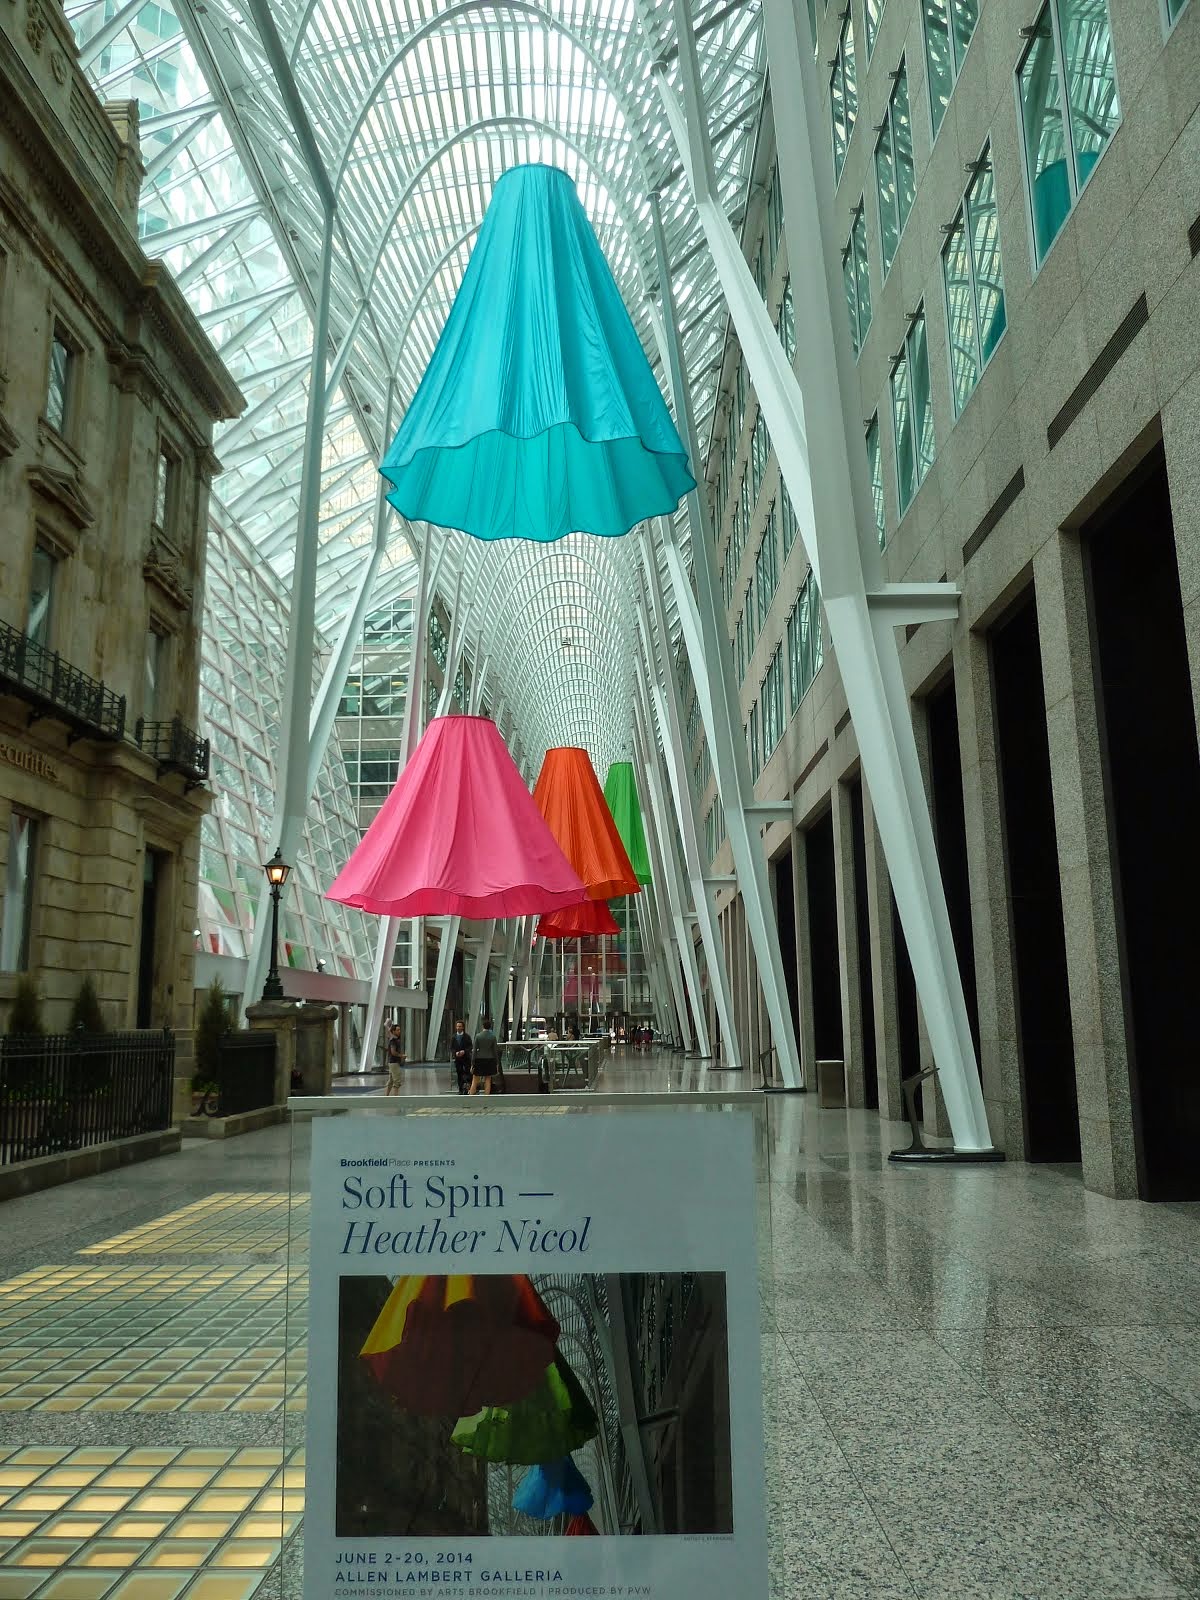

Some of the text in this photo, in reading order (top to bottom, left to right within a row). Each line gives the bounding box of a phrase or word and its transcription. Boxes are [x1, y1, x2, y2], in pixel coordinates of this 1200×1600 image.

[342, 1174, 415, 1209] Soft
[425, 1175, 505, 1217] Spin
[339, 1216, 592, 1255] Heather Nicol
[335, 1552, 377, 1564] JUNE
[436, 1552, 473, 1564] 2014
[335, 1570, 563, 1582] ALLEN LAMBERT GALLERIA
[335, 1588, 416, 1596] COMMISSIONED
[420, 1588, 433, 1596] BY
[438, 1588, 464, 1596] ARTS
[468, 1587, 536, 1596] BROOKFIELD
[549, 1587, 606, 1595] PRODUCED
[610, 1587, 623, 1595] BY
[627, 1586, 651, 1595] PVW
